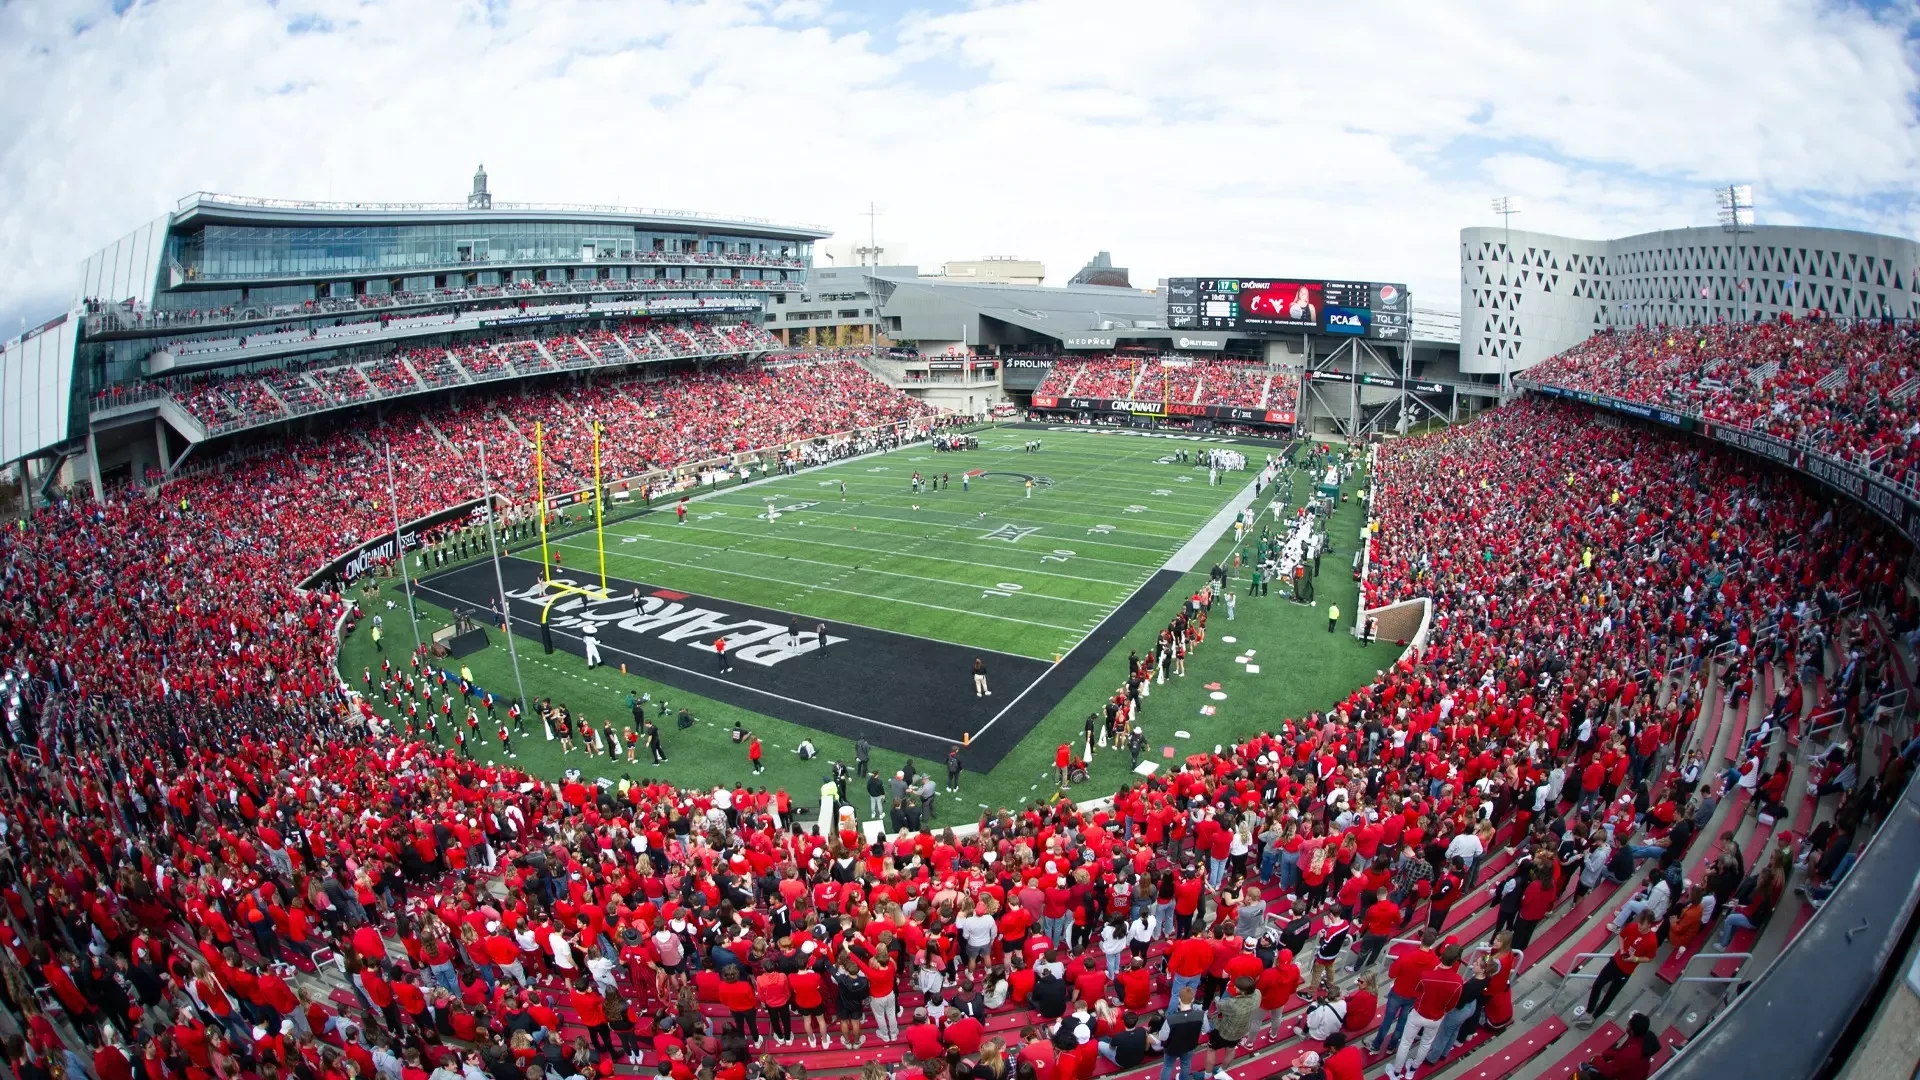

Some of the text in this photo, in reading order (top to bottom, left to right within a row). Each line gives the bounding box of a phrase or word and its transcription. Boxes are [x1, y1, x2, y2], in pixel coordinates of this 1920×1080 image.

[1208, 281, 1214, 290] 7
[1221, 281, 1230, 290] 17
[1241, 281, 1270, 289] CINCINNATI
[1330, 315, 1348, 325] PCA
[1376, 315, 1393, 324] TQL
[1014, 360, 1052, 368] PROLINK
[1111, 400, 1161, 413] CINCINNATI
[1164, 404, 1207, 416] BEARCATS
[1715, 426, 1790, 461] WELCOME TO NIPPERT STADIUM
[1808, 457, 1824, 477] HOME
[1824, 463, 1831, 480] OF
[1840, 470, 1864, 497] BEARCATS
[1039, 549, 1077, 564] 20
[980, 582, 1024, 599] 10
[504, 578, 850, 667] BEARCATS
